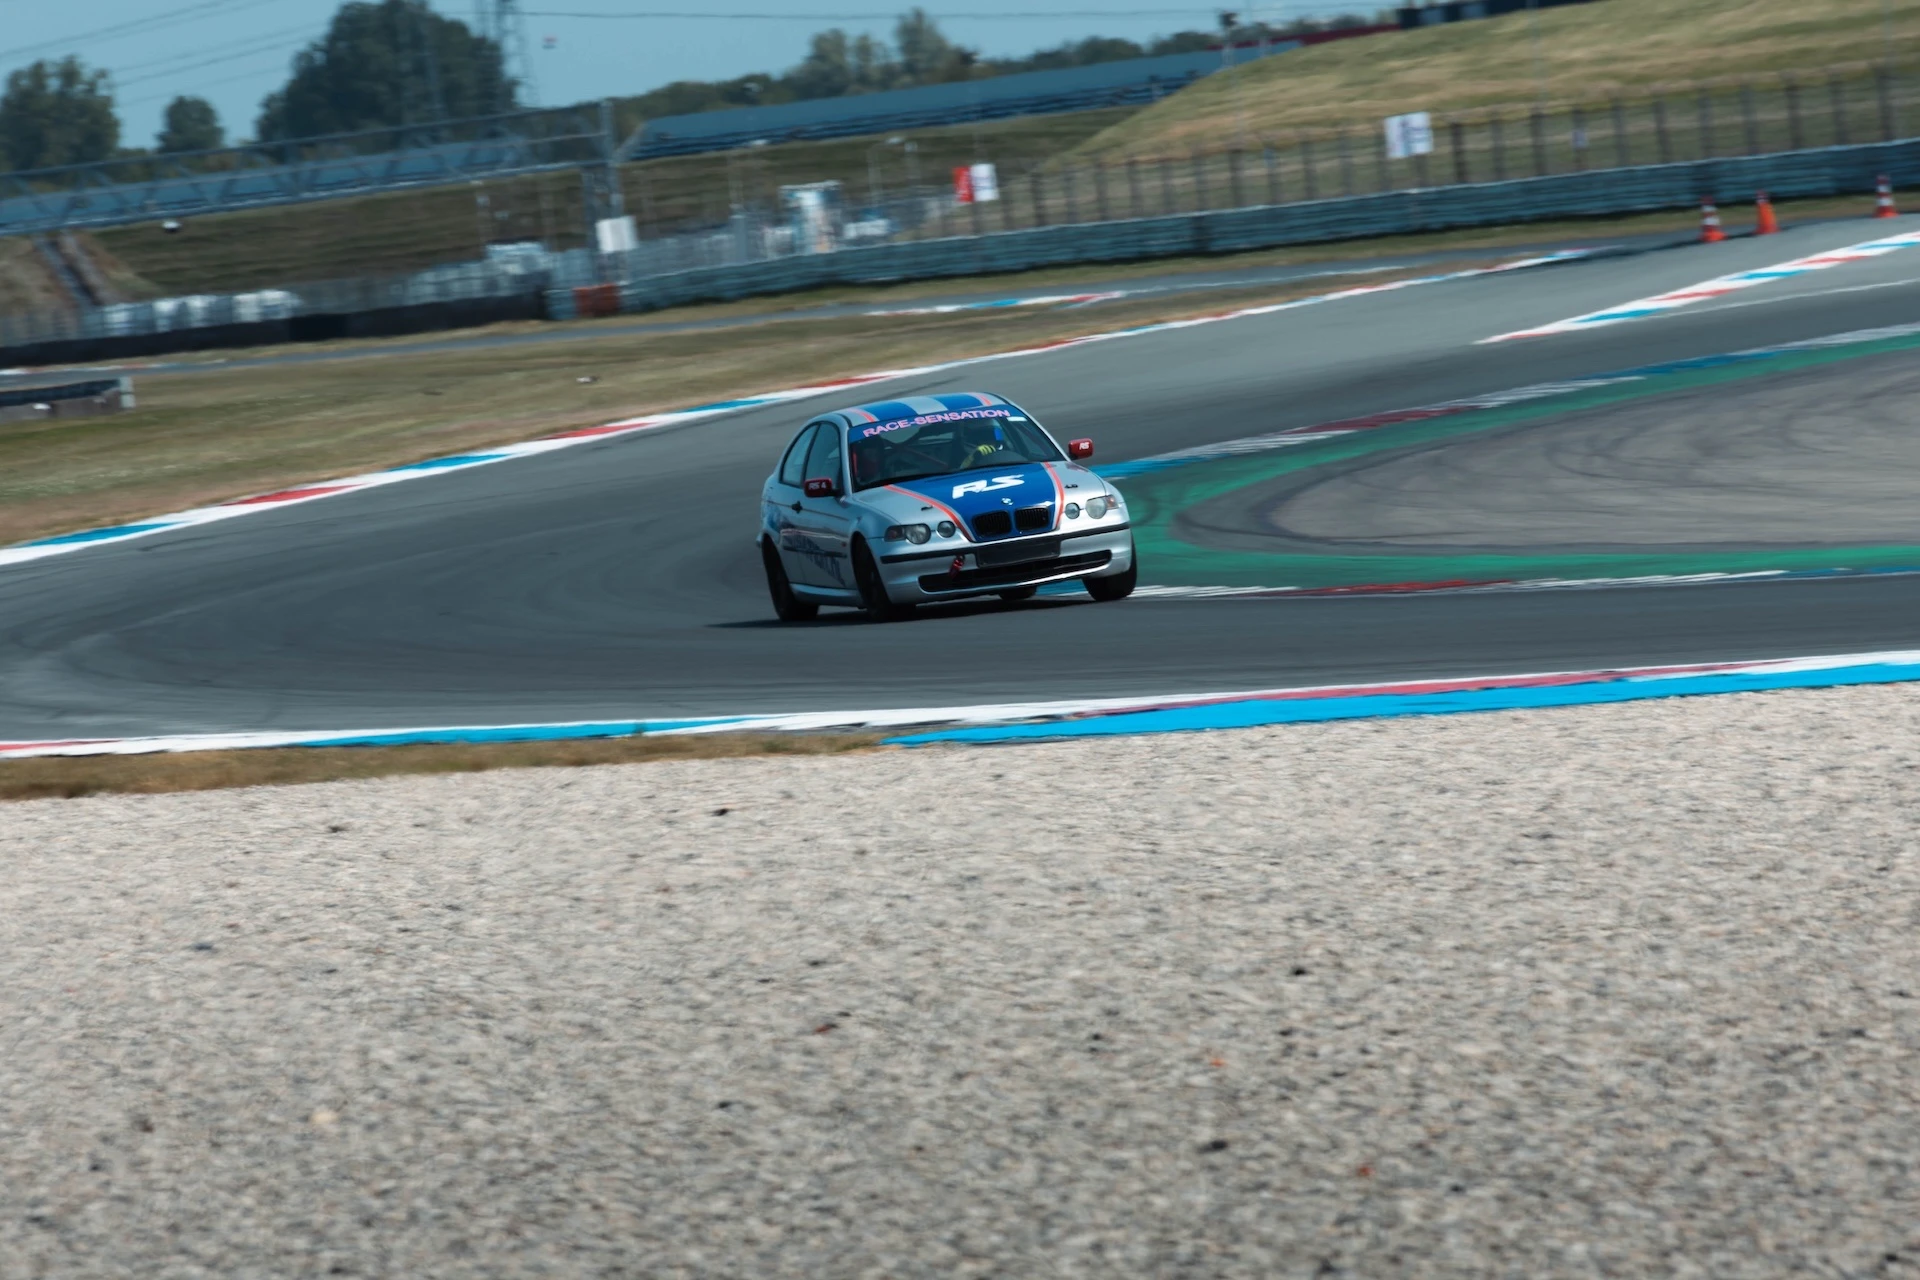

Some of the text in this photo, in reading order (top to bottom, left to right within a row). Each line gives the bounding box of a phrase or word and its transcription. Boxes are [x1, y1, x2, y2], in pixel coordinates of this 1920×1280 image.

[862, 409, 1011, 438] RACE-SENSATION
[1079, 441, 1090, 450] RS
[952, 474, 1025, 499] RS
